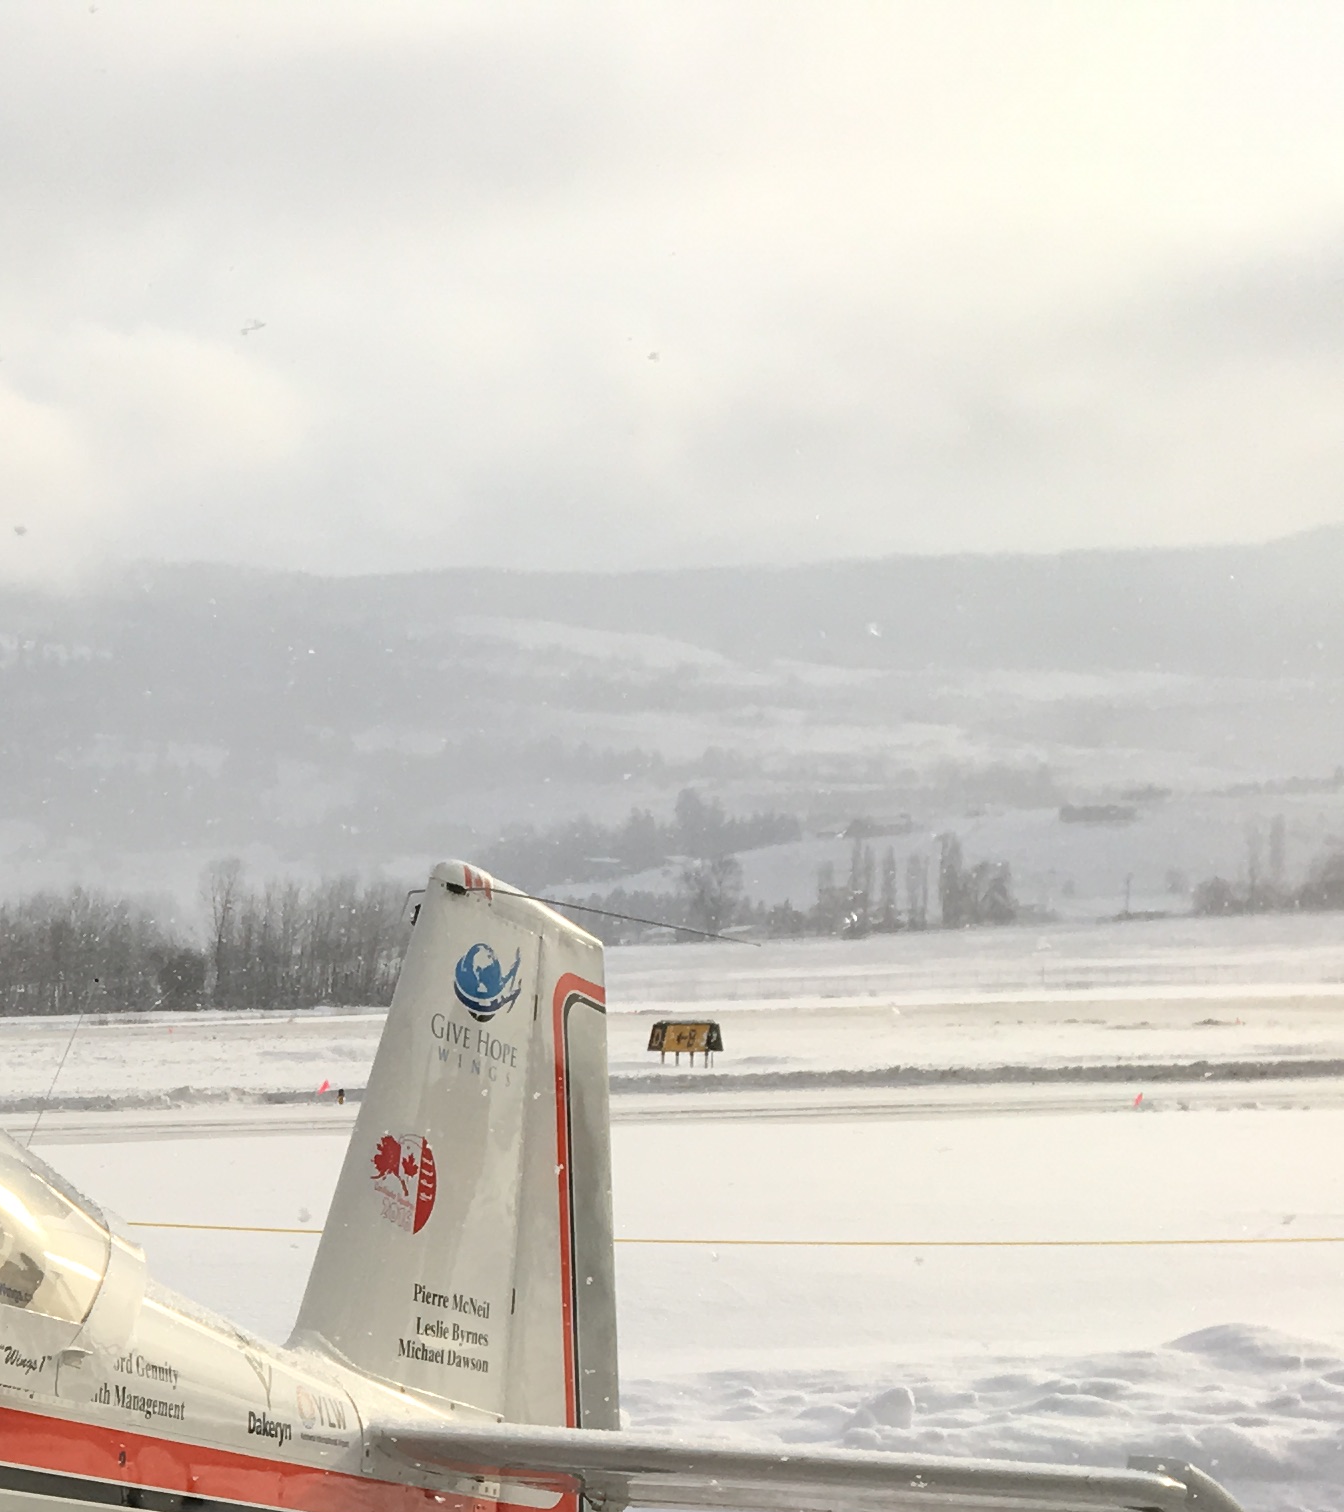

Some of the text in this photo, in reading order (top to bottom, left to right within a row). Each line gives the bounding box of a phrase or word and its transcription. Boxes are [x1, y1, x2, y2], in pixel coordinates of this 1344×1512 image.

[431, 1013, 517, 1068] GIVE HOPE
[438, 1045, 511, 1087] WINGS
[413, 1283, 490, 1319] Pierre McNeil
[416, 1316, 489, 1346] Leslie Byrnes
[136, 1355, 179, 1390] Genuity
[398, 1338, 489, 1373] Michael Dawson
[113, 1384, 185, 1420] Management
[312, 1394, 346, 1430] YLW
[248, 1411, 292, 1447] Dakeryn
